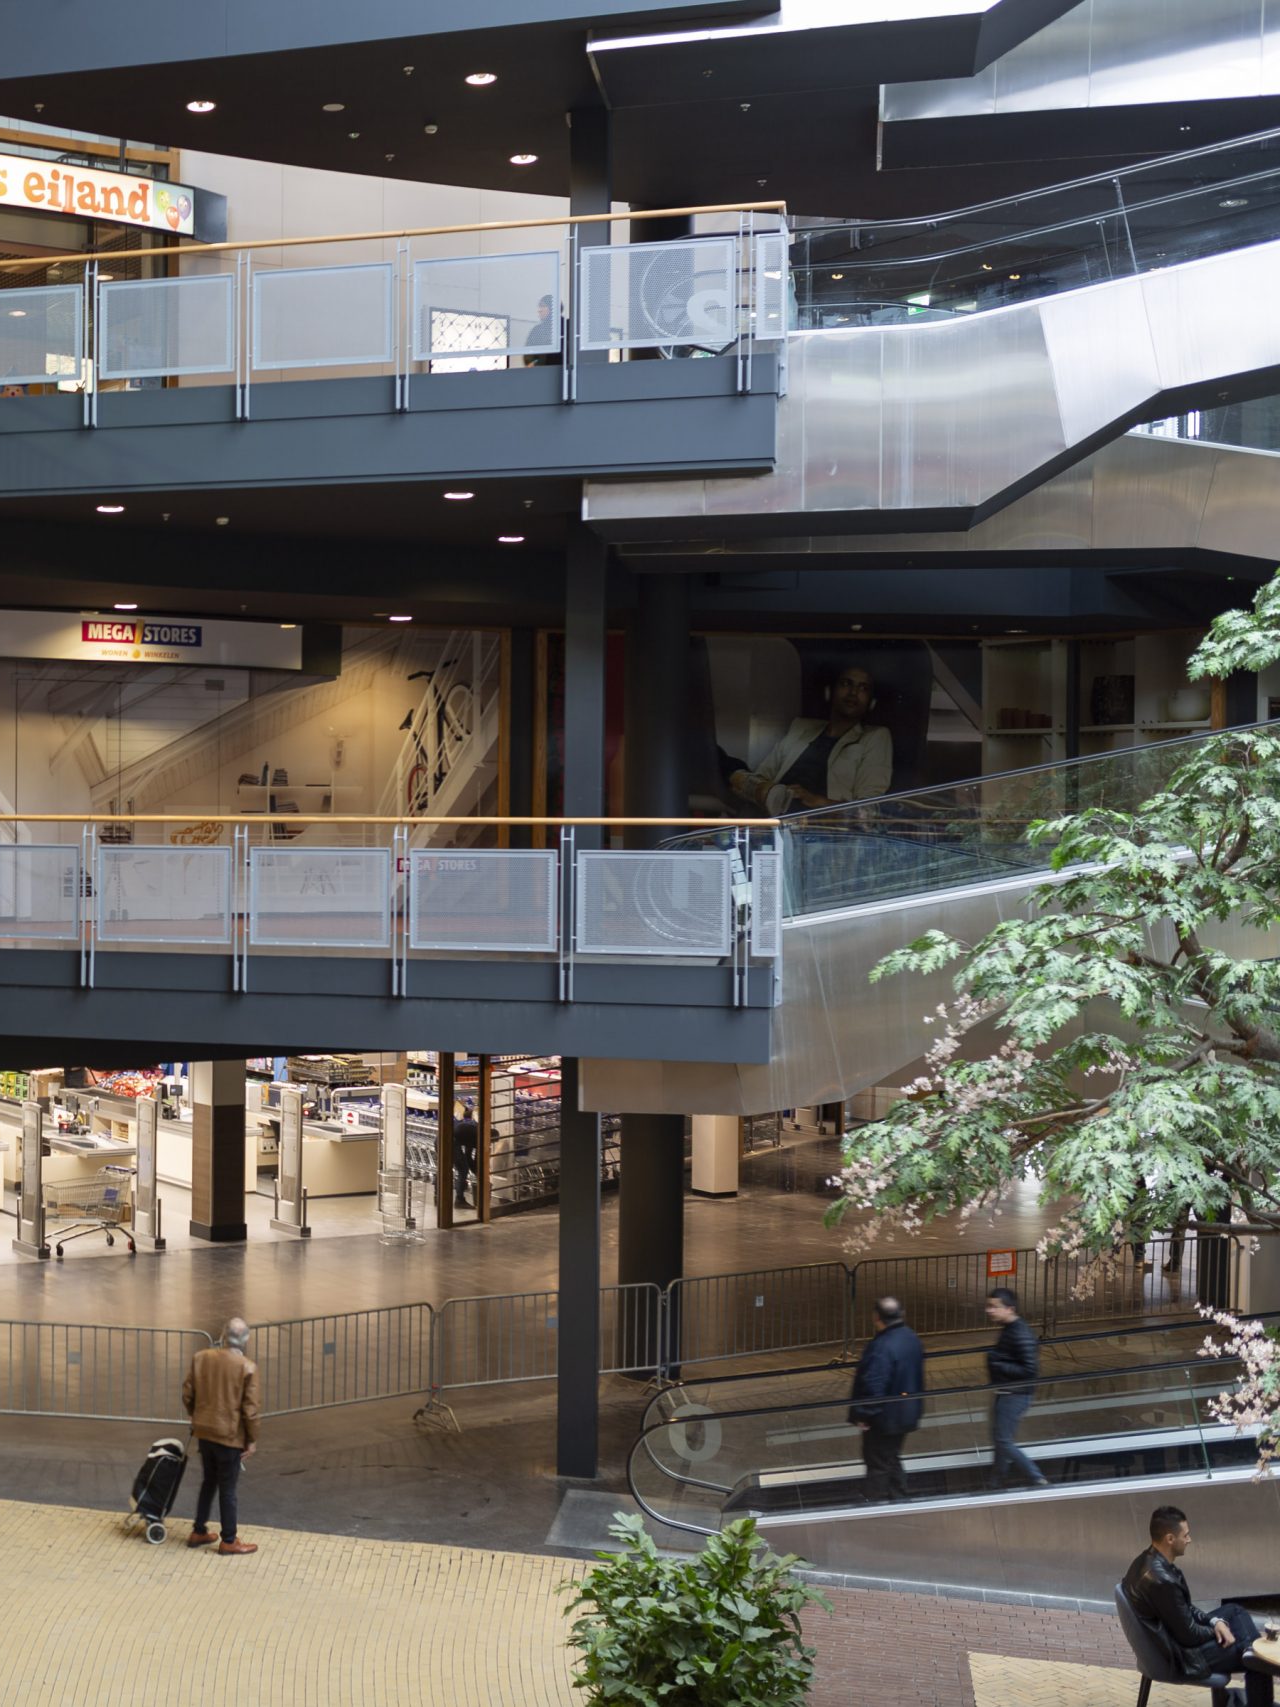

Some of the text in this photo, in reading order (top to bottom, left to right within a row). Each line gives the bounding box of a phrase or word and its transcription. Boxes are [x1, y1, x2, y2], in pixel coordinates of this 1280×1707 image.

[23, 169, 151, 222] eiland
[88, 623, 197, 643] MEGA STORES
[101, 649, 180, 659] WONEN WINKELEN
